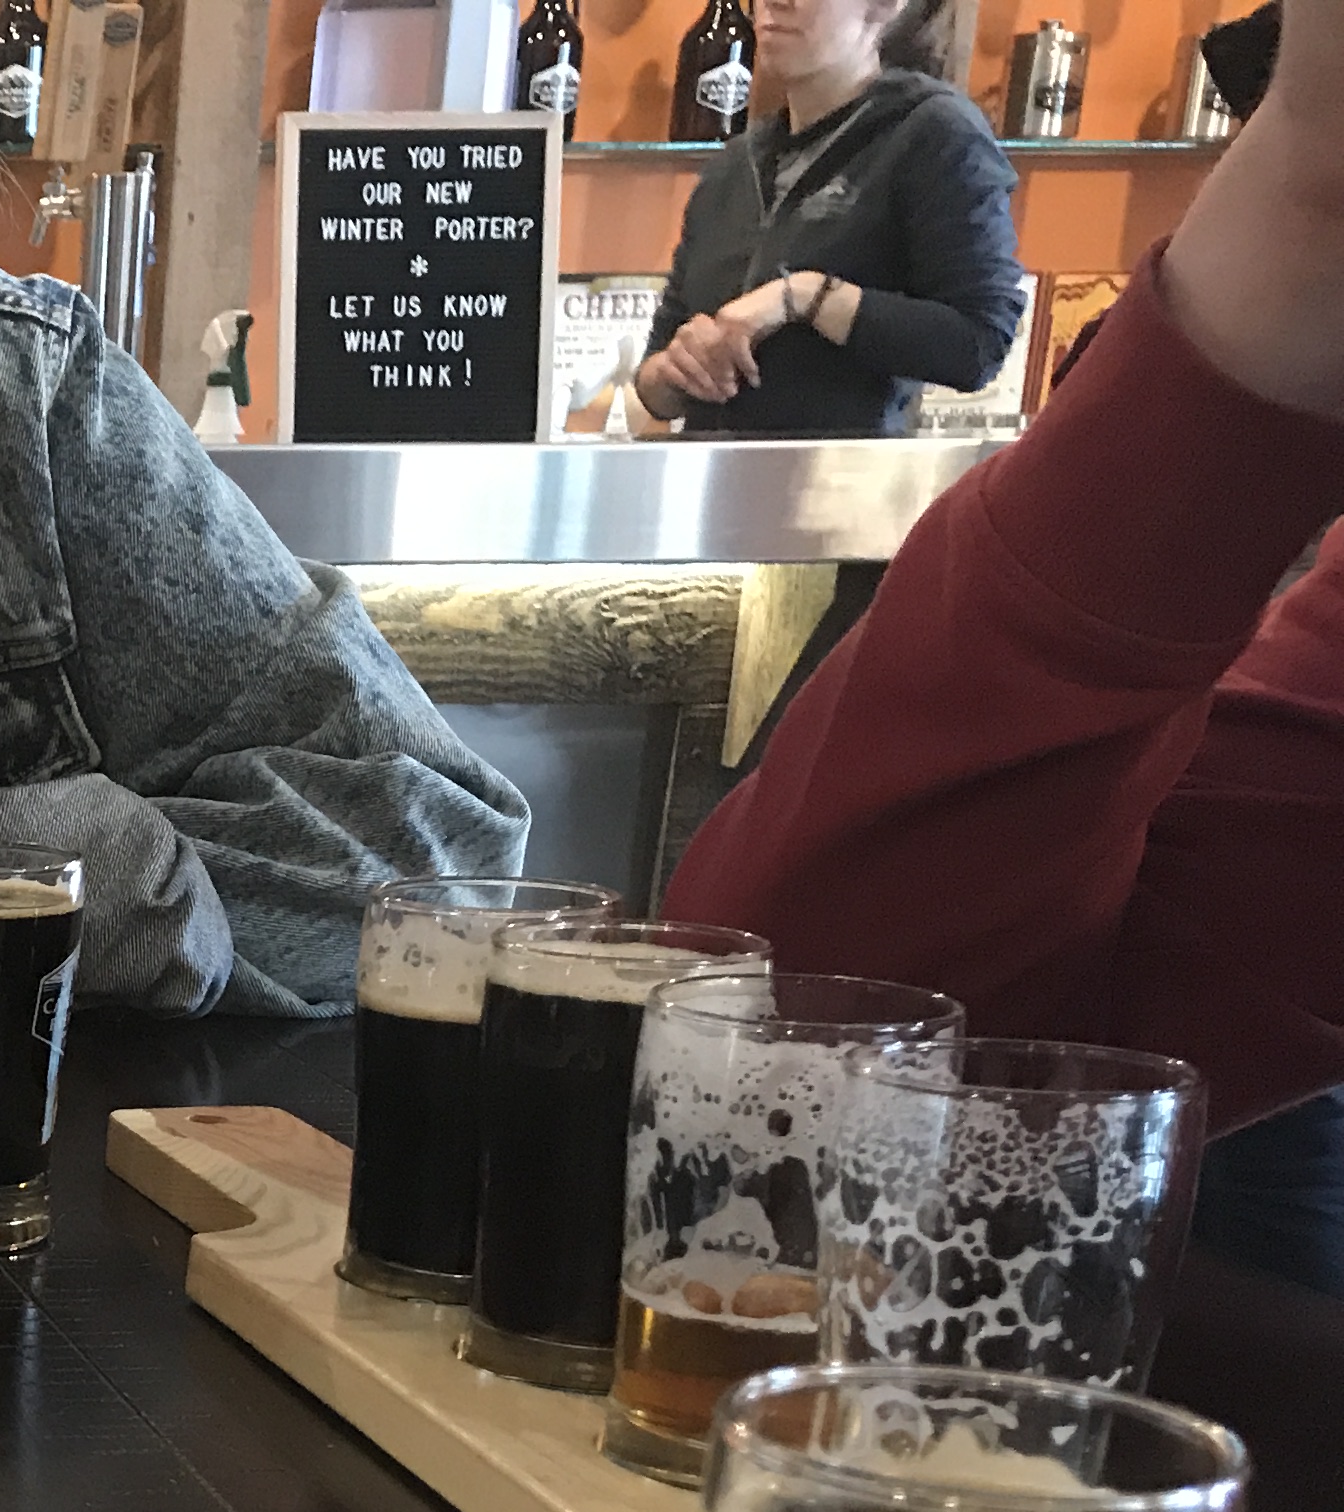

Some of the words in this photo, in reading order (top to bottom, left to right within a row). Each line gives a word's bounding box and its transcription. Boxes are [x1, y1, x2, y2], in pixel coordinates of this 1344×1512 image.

[328, 146, 386, 171] HAVE
[409, 145, 446, 169] YOU
[460, 144, 522, 169] TRIED
[362, 182, 402, 205] OUR
[426, 181, 472, 204] NEW
[321, 217, 404, 242] WINTER
[435, 216, 534, 241] PORTER?
[330, 295, 375, 319] LET
[393, 294, 422, 317] US
[444, 294, 508, 317] KNOW
[343, 330, 404, 353] WHAT
[422, 329, 464, 351] YOU
